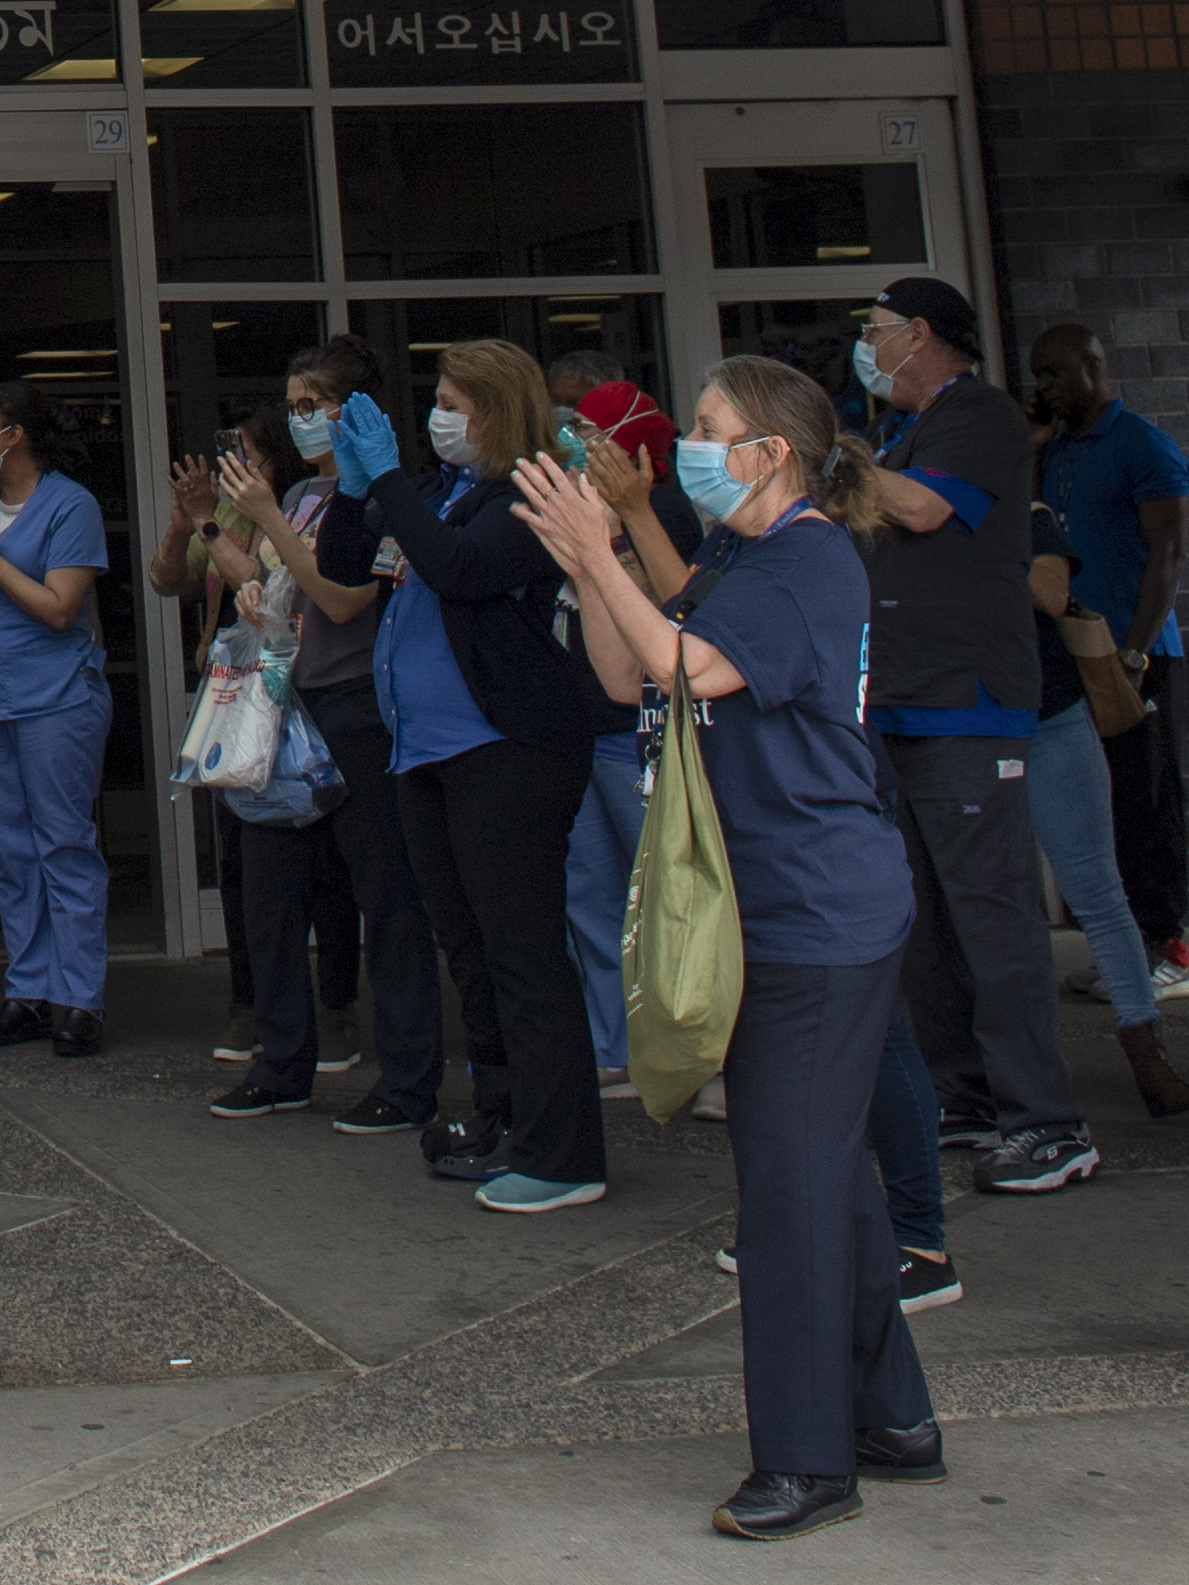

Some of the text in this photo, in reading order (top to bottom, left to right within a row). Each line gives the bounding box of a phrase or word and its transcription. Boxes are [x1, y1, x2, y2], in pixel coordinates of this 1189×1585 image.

[336, 11, 622, 56] 어서오십시오
[93, 119, 123, 145] 29
[888, 120, 916, 145] 27
